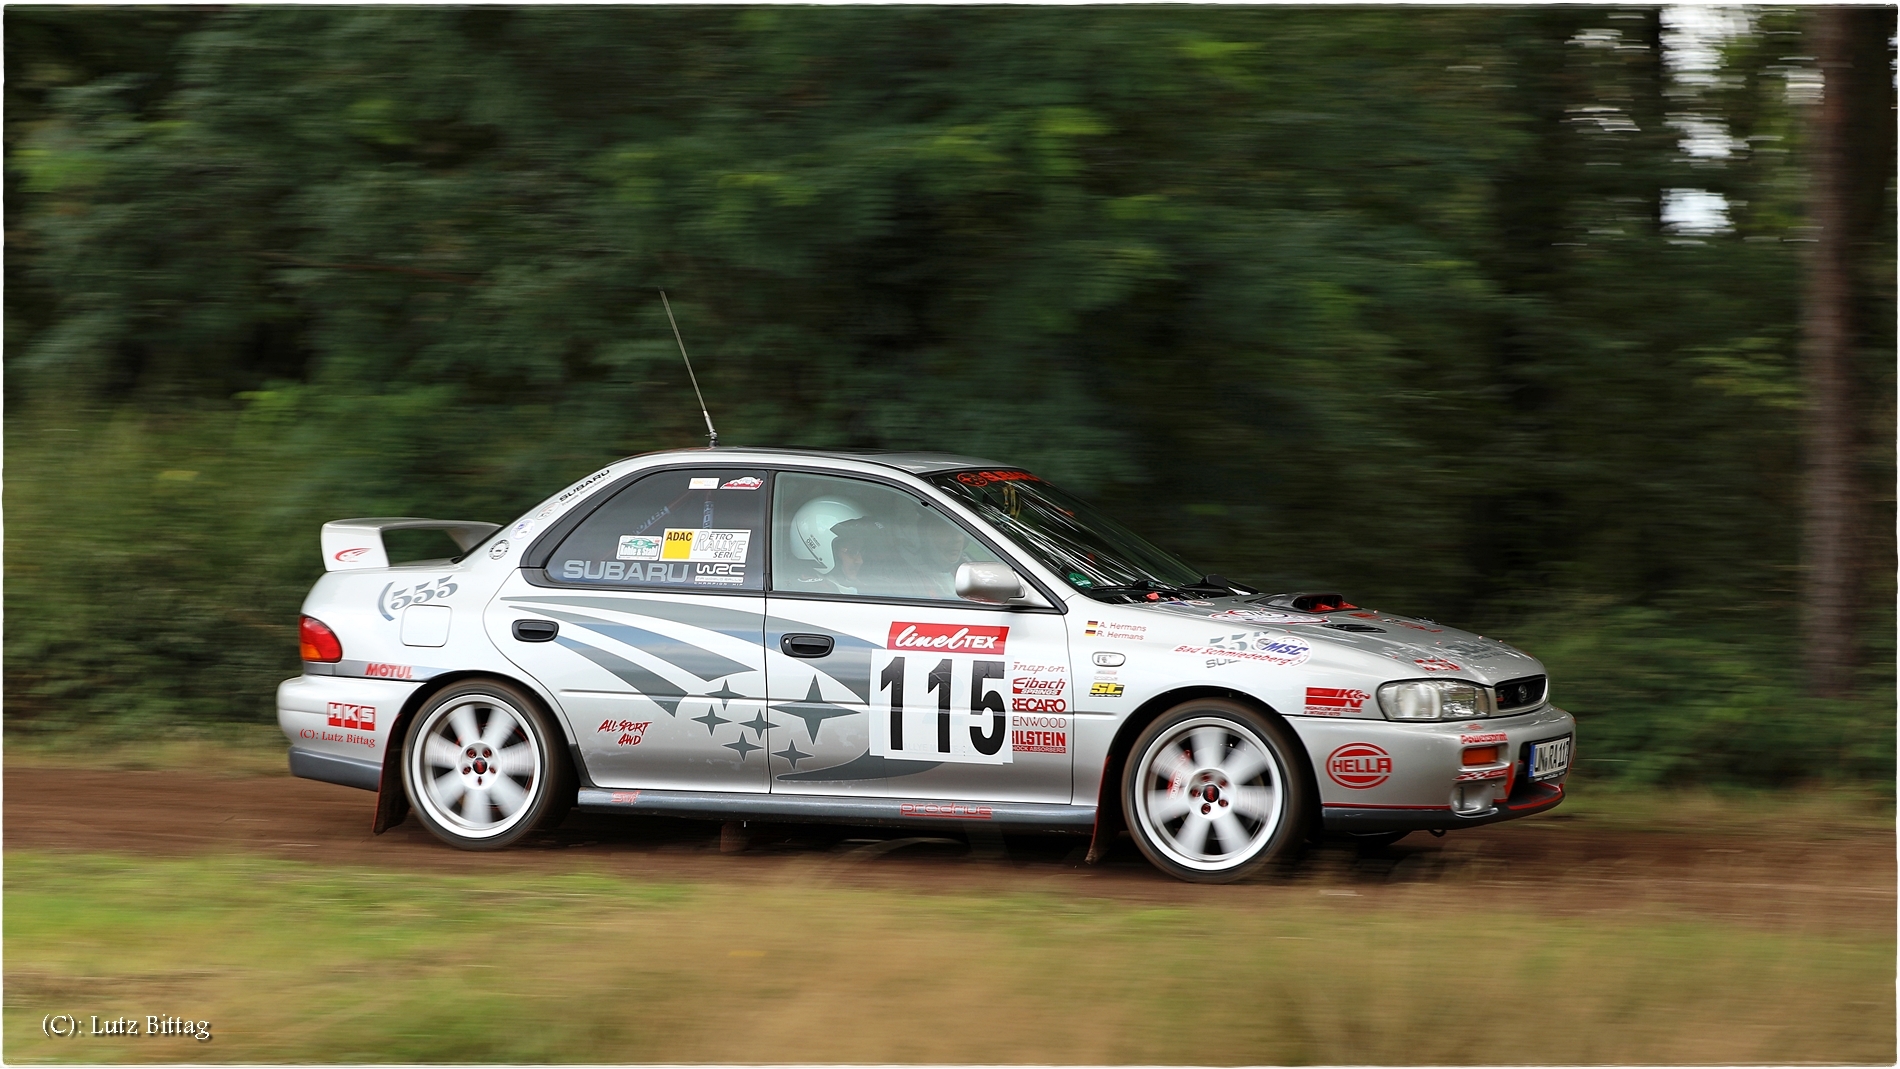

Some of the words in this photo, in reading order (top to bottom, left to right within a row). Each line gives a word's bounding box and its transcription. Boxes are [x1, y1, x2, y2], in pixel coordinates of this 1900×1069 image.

[559, 470, 610, 502] SUBARU
[666, 532, 693, 542] ADAC
[562, 560, 690, 583] SUBARU
[696, 562, 746, 575] WRC
[1110, 622, 1147, 632] Hermans
[1107, 631, 1144, 641] Hermans
[1174, 645, 1199, 654] Bad
[1201, 647, 1291, 666] Schmiedeberg
[1263, 642, 1310, 656] MSC
[364, 663, 412, 679] MOTUL
[1013, 677, 1066, 690] Eibach
[327, 702, 375, 724] HKS
[880, 656, 1006, 756] 115
[1012, 697, 1067, 713] RECARO
[1012, 716, 1067, 728] ENWOOD
[1332, 757, 1392, 774] HELLA
